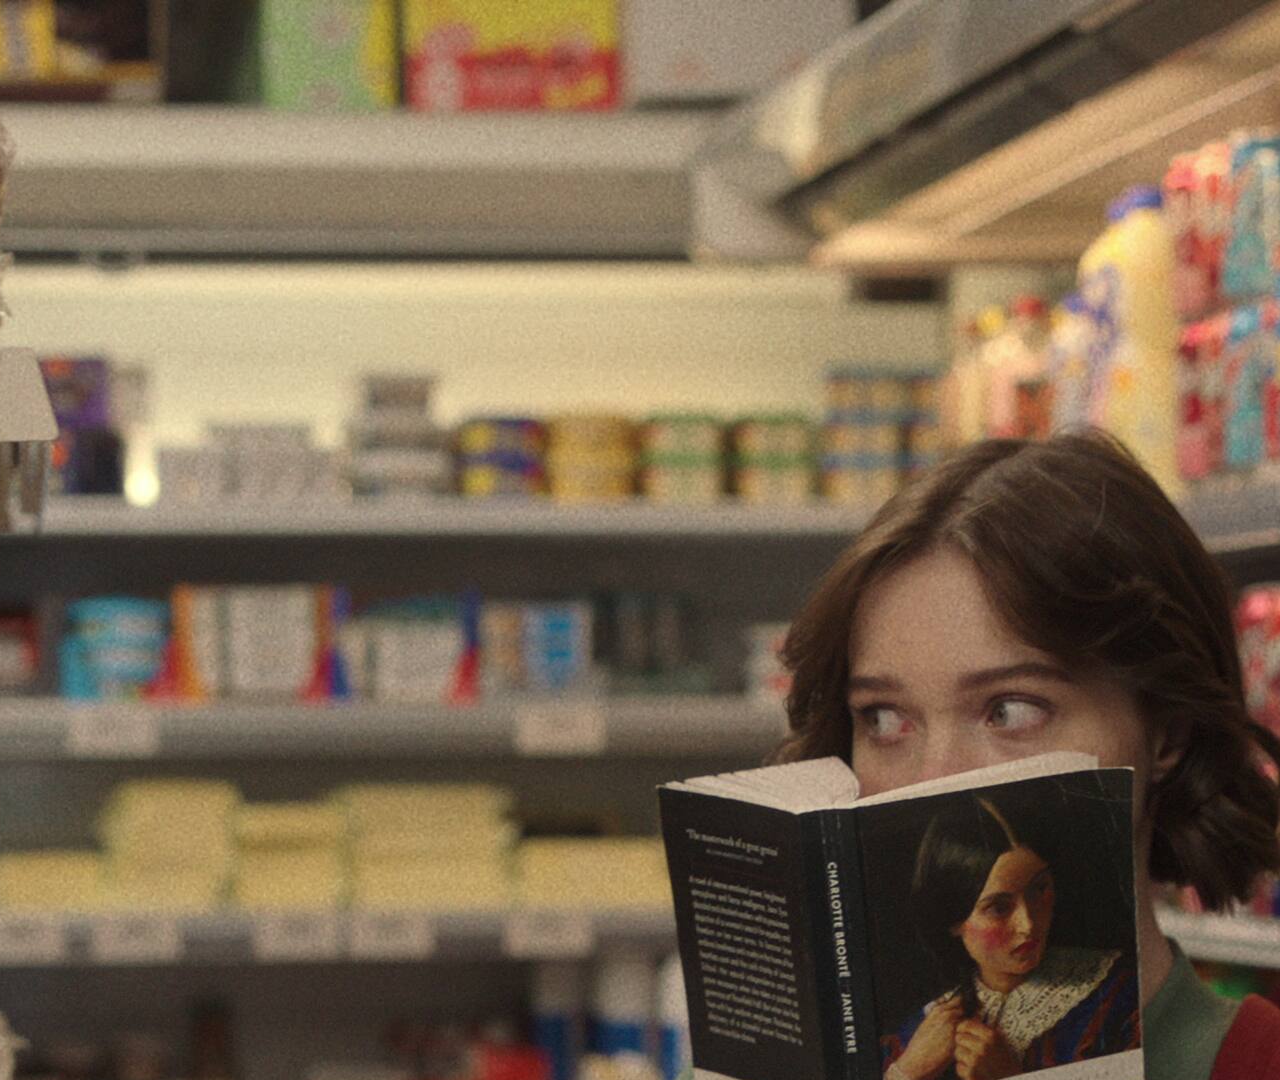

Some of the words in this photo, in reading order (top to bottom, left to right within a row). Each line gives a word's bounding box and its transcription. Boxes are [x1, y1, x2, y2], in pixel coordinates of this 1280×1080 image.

[827, 861, 844, 929] CHARLOTTE
[840, 992, 854, 1023] JANE
[844, 1025, 858, 1054] EYRE
